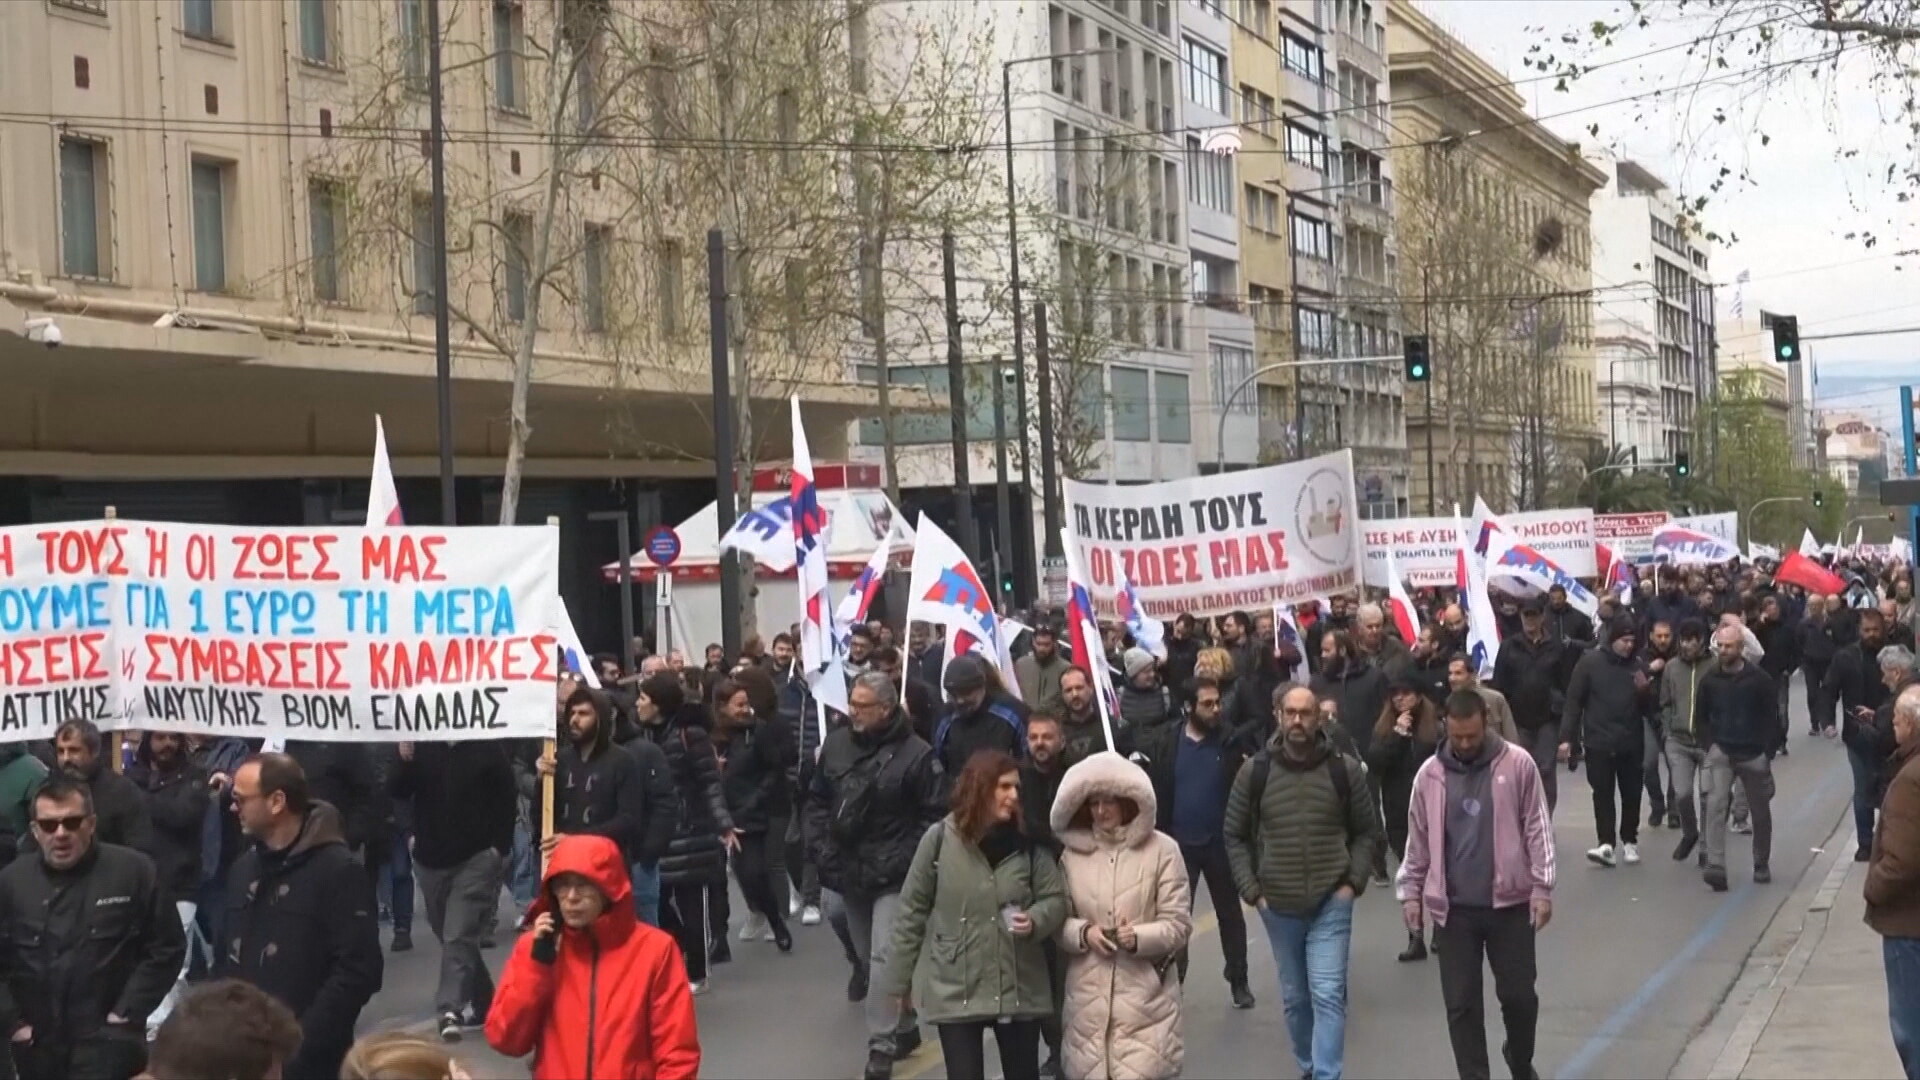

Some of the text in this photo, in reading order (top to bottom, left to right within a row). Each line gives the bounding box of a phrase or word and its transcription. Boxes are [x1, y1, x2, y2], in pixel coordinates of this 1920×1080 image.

[1074, 503, 1092, 538] ΤΑ
[1095, 503, 1184, 541] ΚΕΡΔΗ
[1190, 492, 1267, 534] ΤΟΥΣ
[1393, 530, 1415, 544] ΜΕ
[1420, 528, 1457, 543] ΑΥΞΗ
[1524, 520, 1588, 537] ΜΙΣΘΟΥΣ
[37, 527, 129, 575] ΤΟΥΣ
[185, 533, 215, 581] ΟΙ
[231, 533, 341, 581] ΖΩΕΣ
[362, 535, 447, 583] ΜΑΣ
[1091, 531, 1289, 587] ΟΙ ΖΩΕΣ ΜΑΣ
[1367, 550, 1387, 560] ΜΕΤΡ
[0, 582, 515, 636] ΟΥΜΕ ΓΙΑ 1 ΕΥΡΩ ΤΗ ΜΕΡΑ
[145, 634, 351, 690] ΣΥΜΒΑΣΕΙΣ
[369, 635, 558, 690] ΚΛΑΔΙΚΕΣ
[1, 685, 112, 731] ΑΤΤΙΚΗΣ
[371, 687, 509, 731] ΕΛΛΑΔΑΣ
